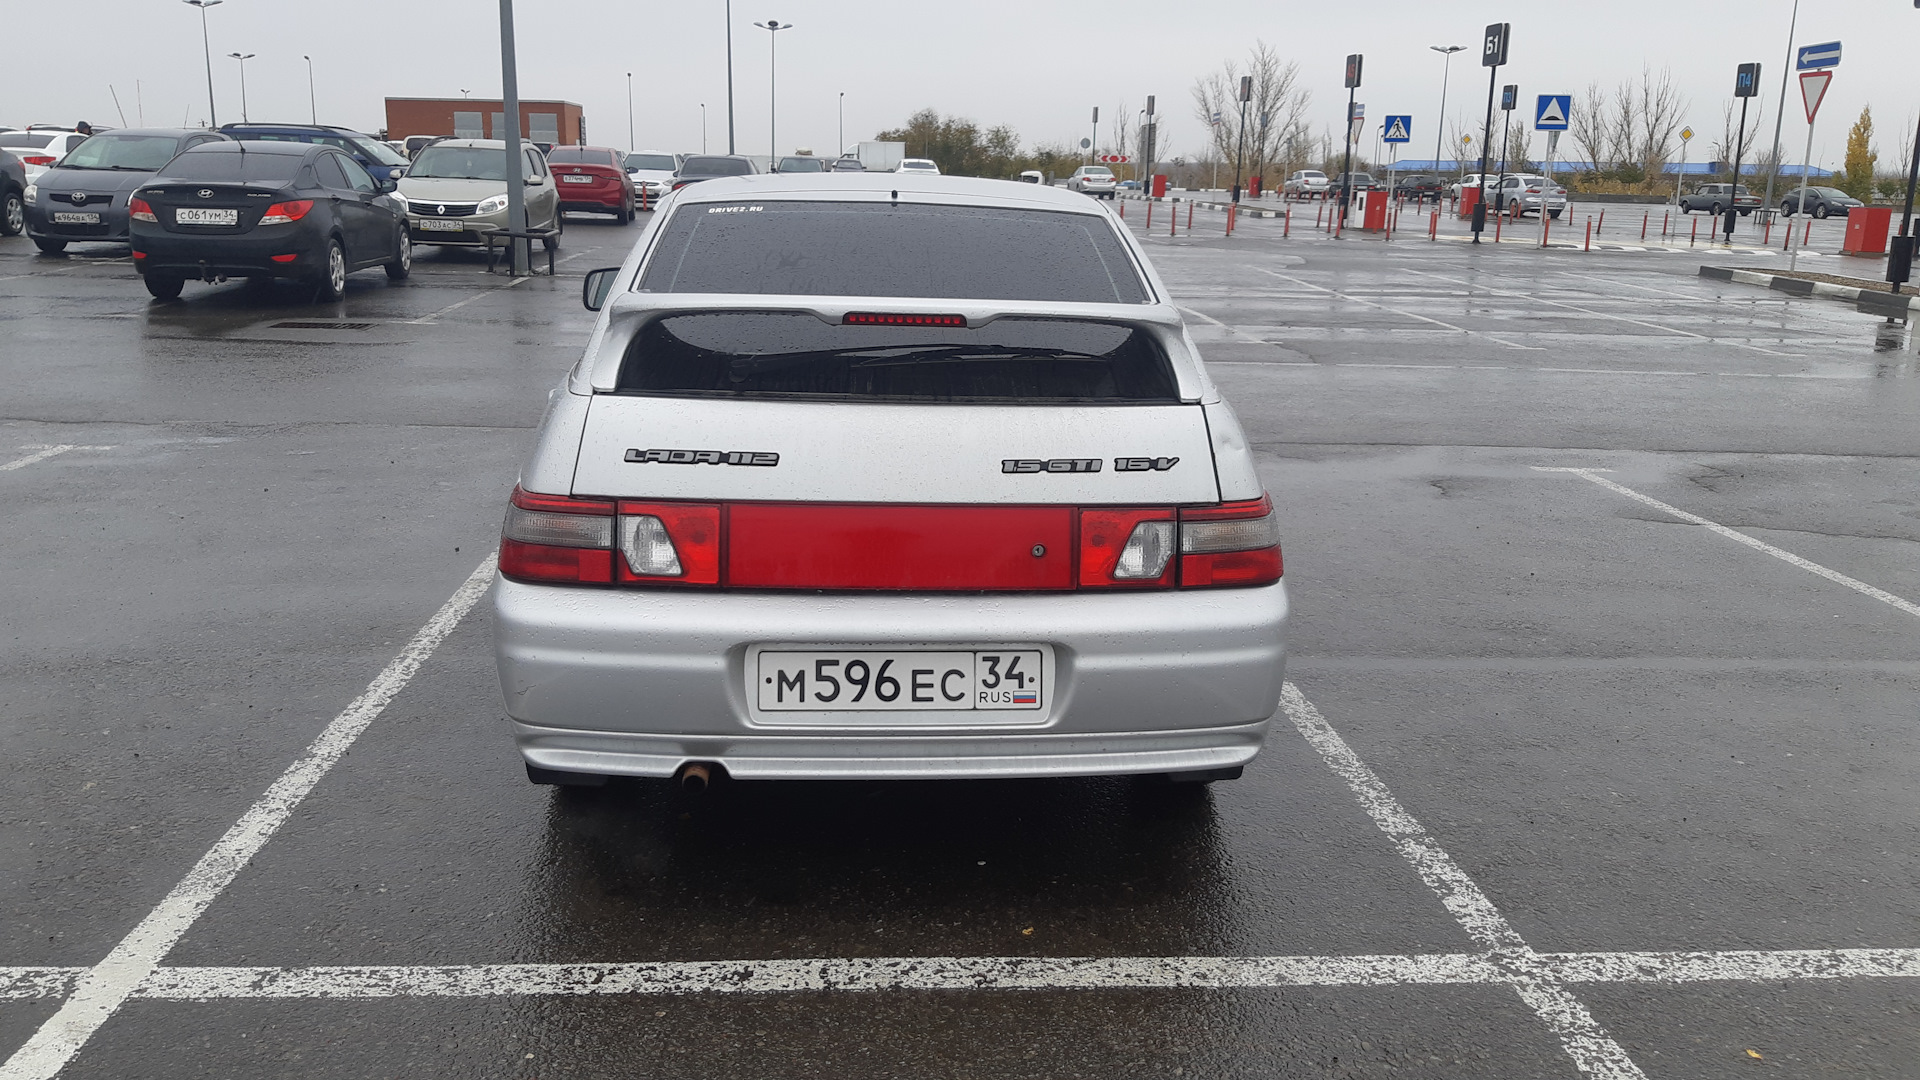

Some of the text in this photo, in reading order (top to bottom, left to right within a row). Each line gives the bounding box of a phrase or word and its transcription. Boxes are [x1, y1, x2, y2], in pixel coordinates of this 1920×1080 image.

[1486, 35, 1499, 55] Б1
[1738, 73, 1751, 87] П4
[224, 210, 234, 218] 34
[708, 206, 763, 214] DRIVE2.RU
[777, 656, 1024, 703] М596ЕС 34
[979, 691, 1011, 703] RUS
